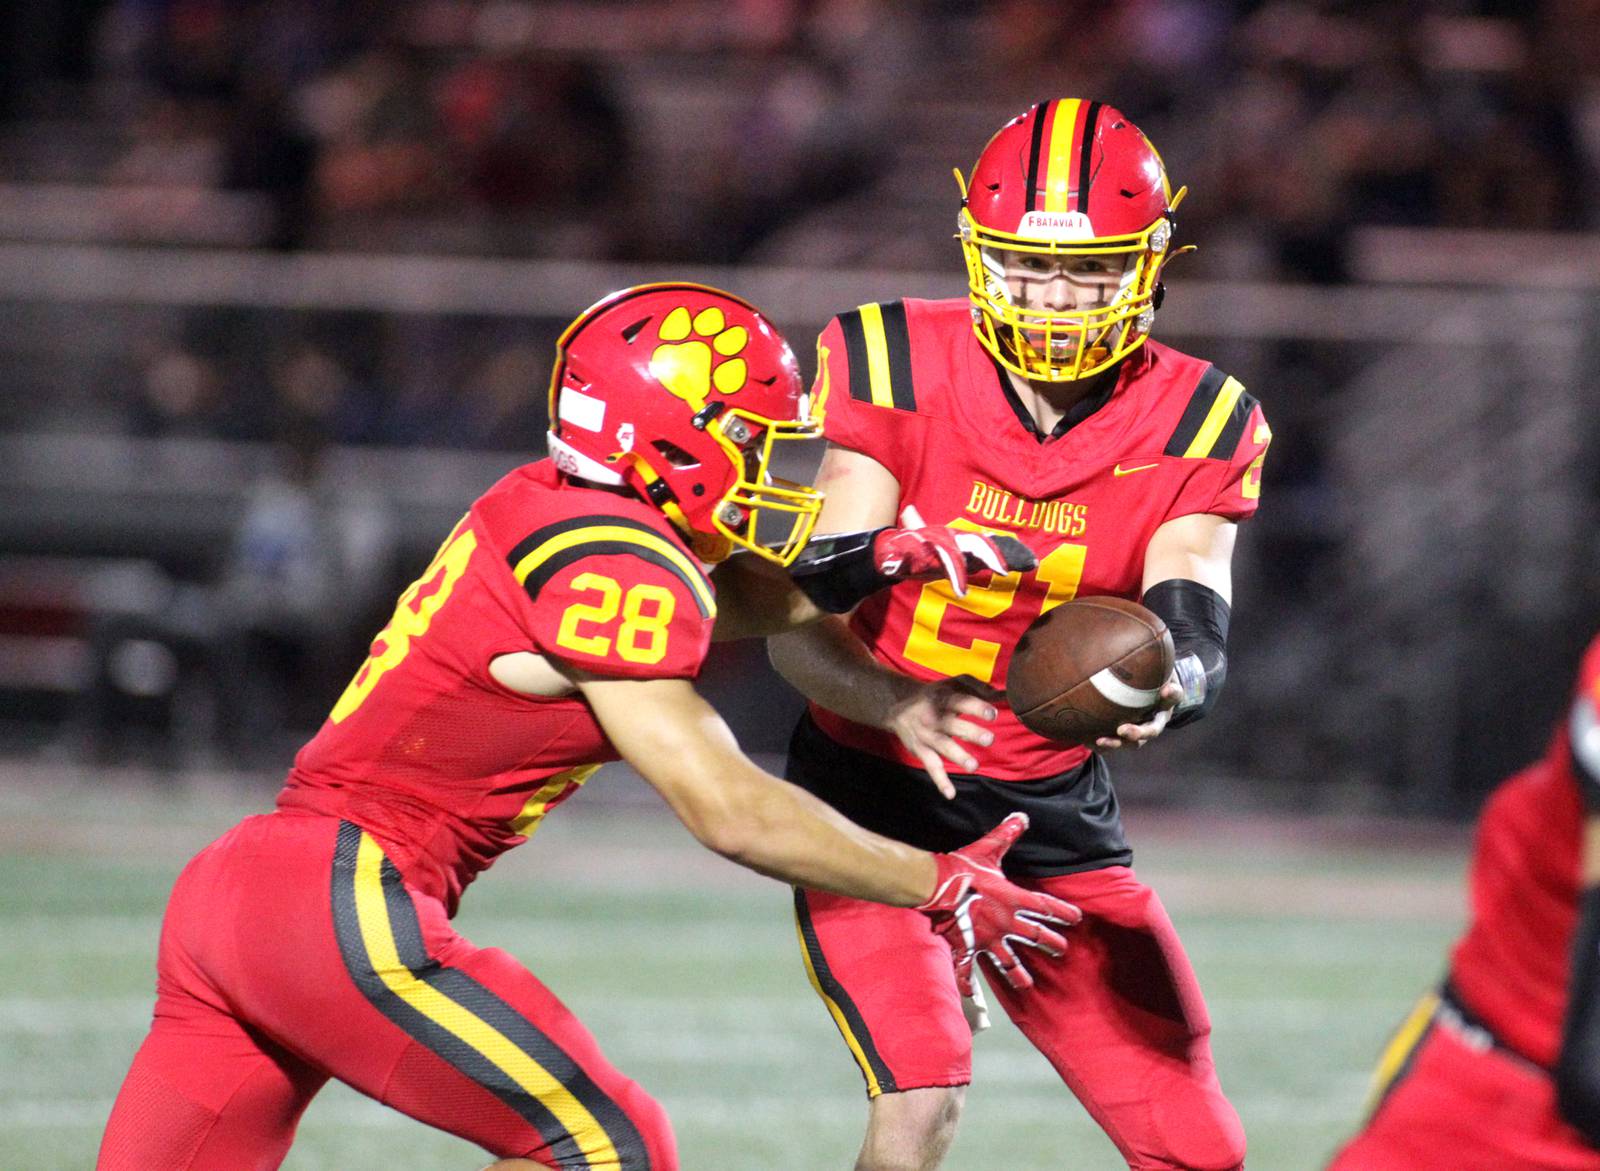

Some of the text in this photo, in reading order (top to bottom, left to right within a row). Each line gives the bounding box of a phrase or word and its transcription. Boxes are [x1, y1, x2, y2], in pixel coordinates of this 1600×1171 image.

[1036, 216, 1074, 228] BATAVIA
[965, 480, 1088, 536] BULLDOGS
[556, 571, 676, 665] 28
